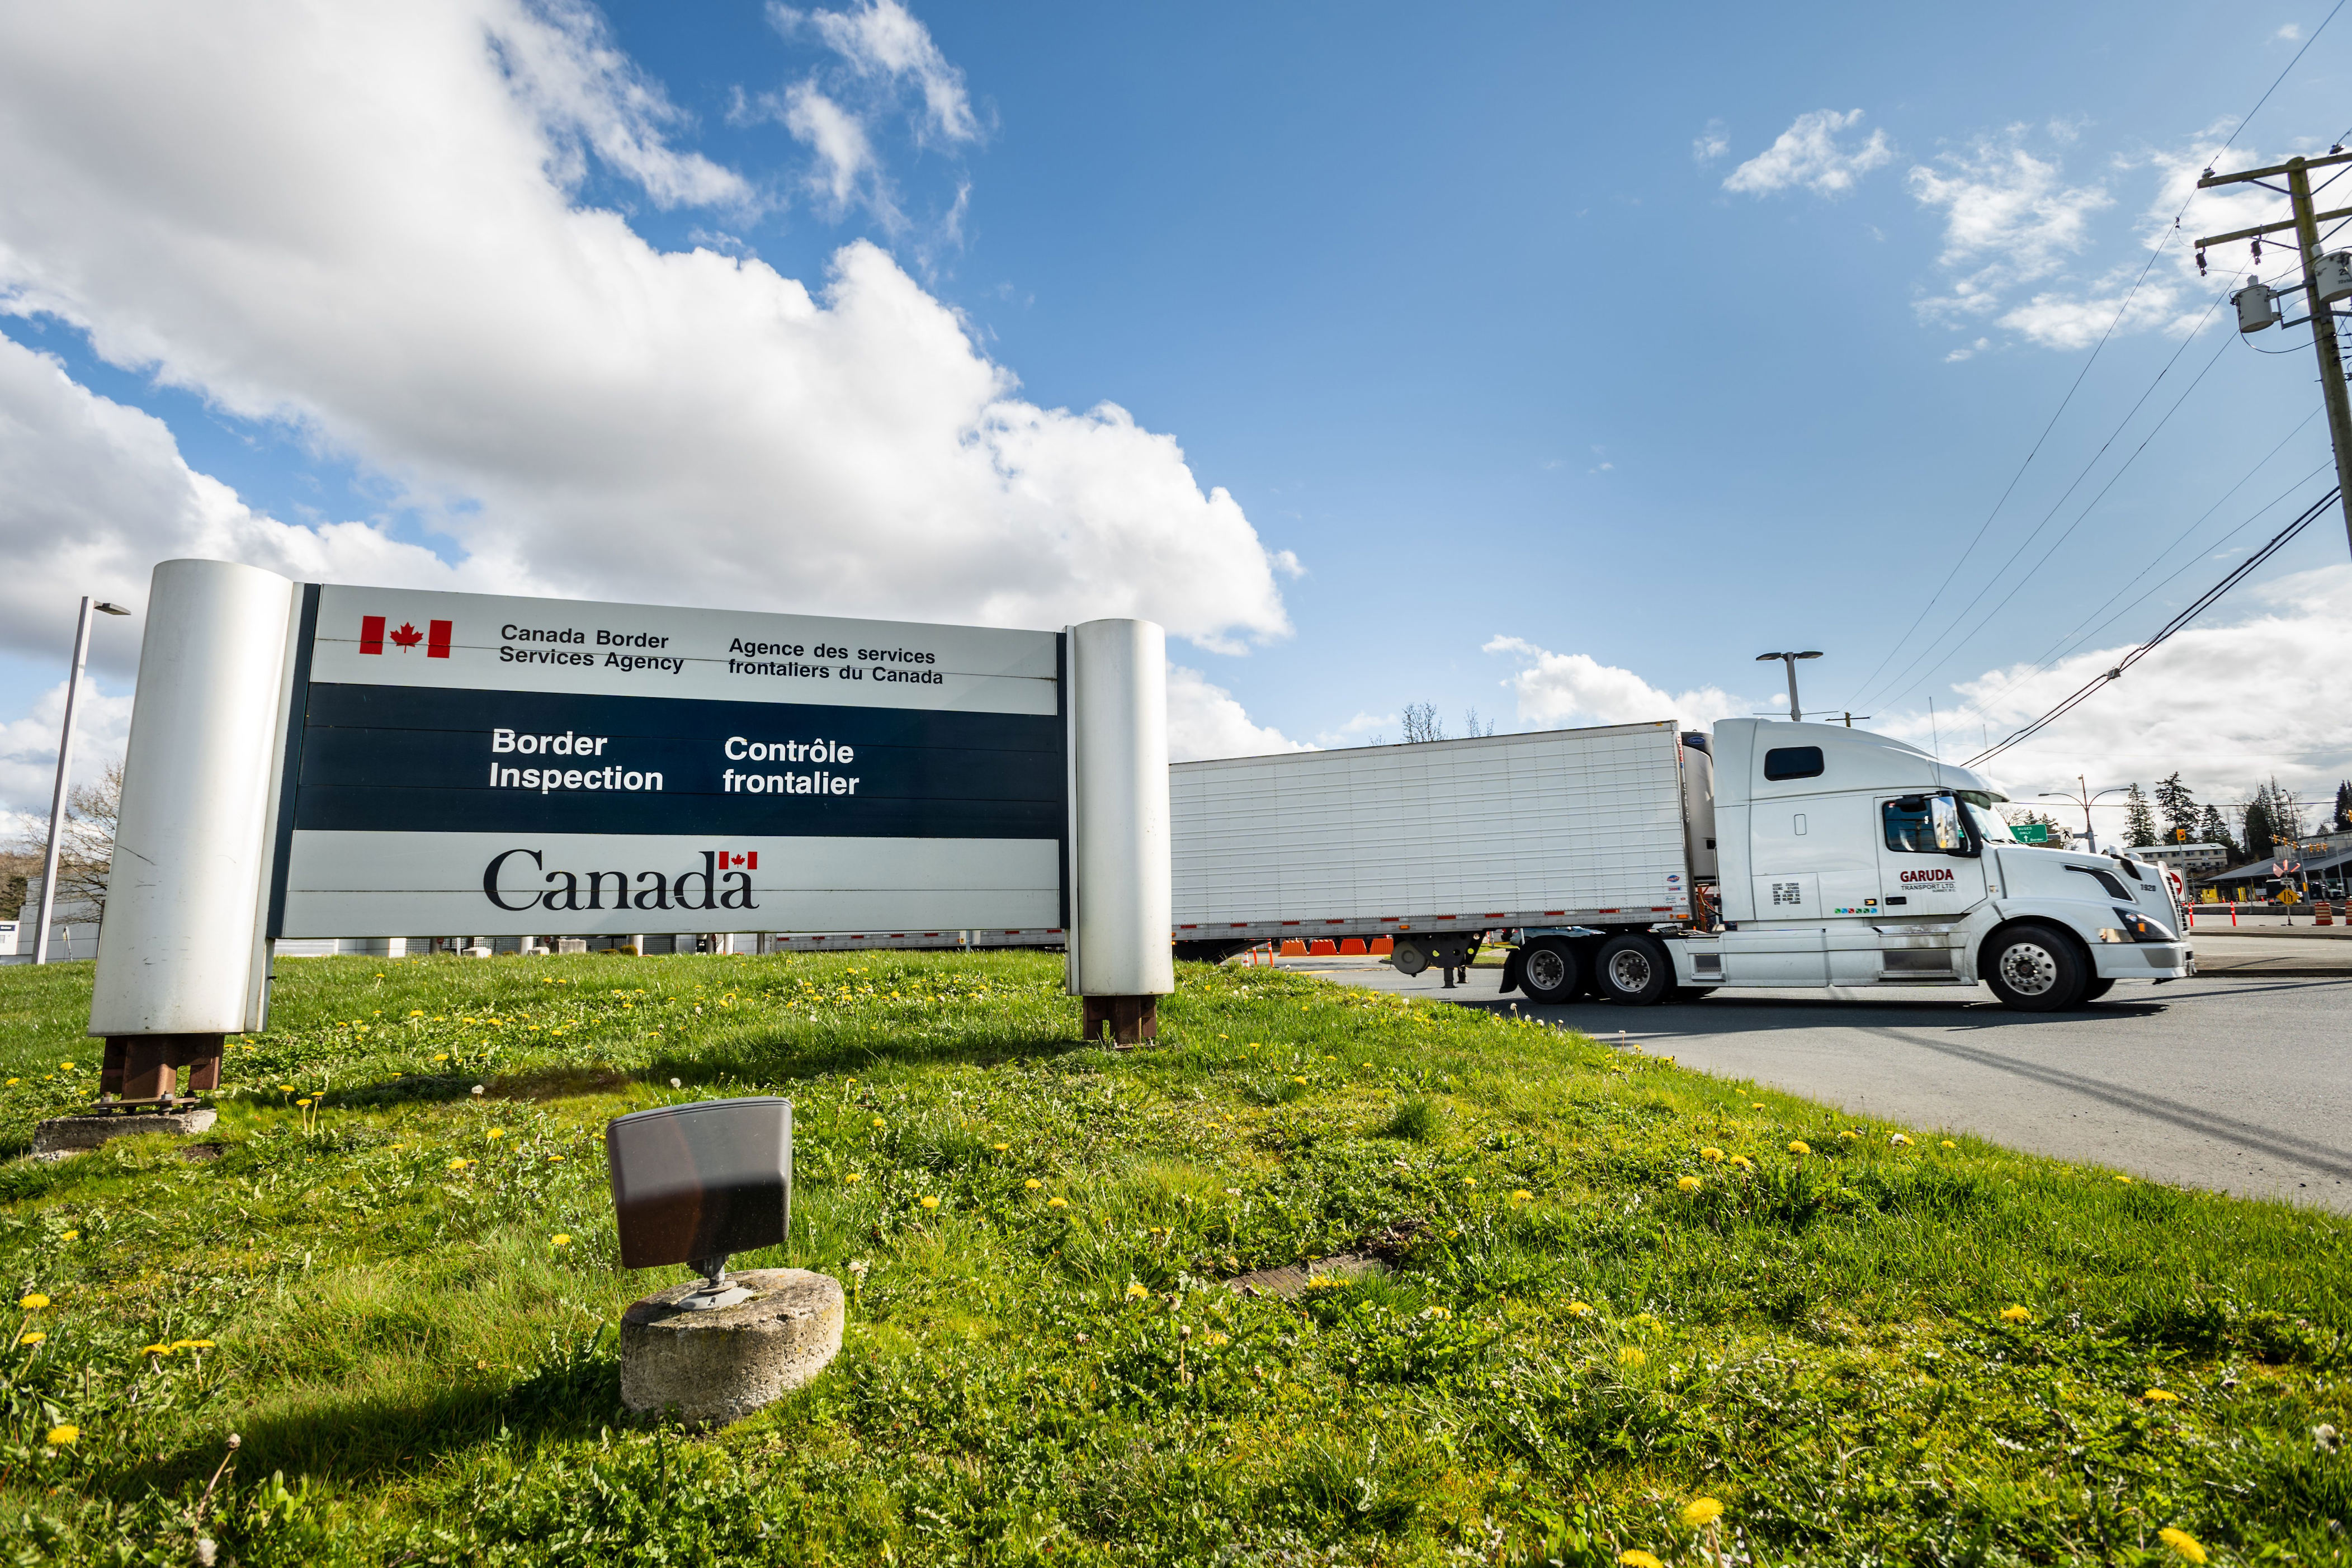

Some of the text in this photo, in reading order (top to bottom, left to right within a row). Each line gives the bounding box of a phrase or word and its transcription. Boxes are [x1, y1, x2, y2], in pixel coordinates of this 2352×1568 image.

[502, 624, 669, 648] Canada Border
[499, 646, 684, 674] Services Agency
[729, 638, 935, 664] Agence des services
[729, 659, 943, 684] frontaliers du Canada
[492, 728, 608, 756] Border
[725, 736, 854, 764] Contrôle
[489, 762, 664, 795] Inspection
[722, 769, 860, 795] frontalier
[483, 849, 760, 911] Canada
[1900, 868, 1954, 882] GARUDA
